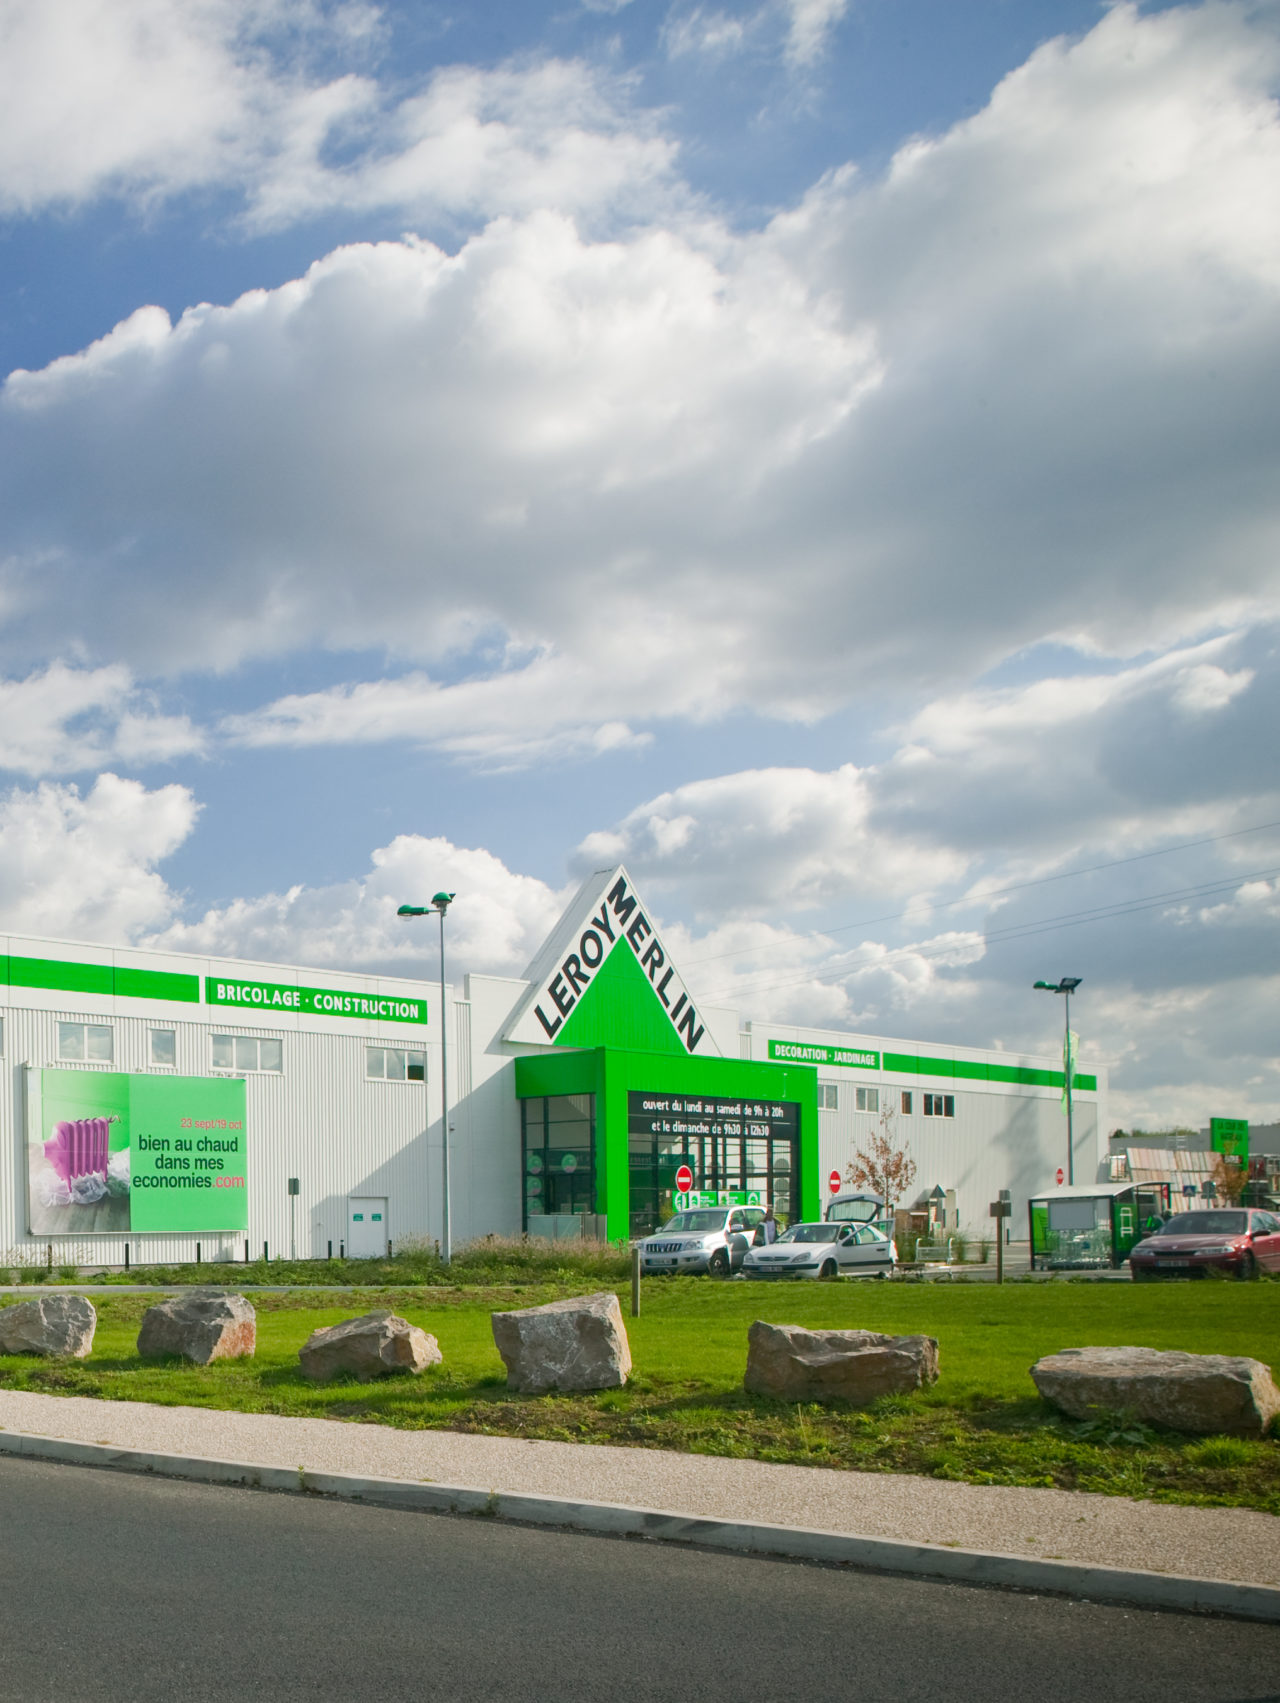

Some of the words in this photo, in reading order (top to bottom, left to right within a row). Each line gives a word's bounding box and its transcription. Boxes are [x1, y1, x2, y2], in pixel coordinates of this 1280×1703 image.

[533, 902, 616, 1040] LEROY
[606, 875, 706, 1054] MERLIN
[217, 984, 300, 1007] BRICOLAGE
[313, 994, 419, 1019] CONSTRUCTION
[775, 1044, 827, 1061] DECORATION
[833, 1051, 875, 1066] JARDINAGE
[642, 1100, 669, 1111] ouvert
[671, 1100, 682, 1111] du
[684, 1100, 702, 1112] lundi
[704, 1104, 714, 1114] au
[716, 1103, 741, 1115] samedi
[754, 1105, 763, 1117] 9h
[771, 1107, 784, 1118] 20h
[181, 1118, 192, 1128] 23
[228, 1120, 243, 1130] oct
[651, 1120, 661, 1131] et
[663, 1120, 670, 1132] le
[672, 1121, 710, 1134] dimanche
[712, 1123, 722, 1134] de
[724, 1123, 741, 1135] 9h30
[750, 1125, 769, 1137] 12h30
[138, 1134, 170, 1151] bien
[174, 1139, 193, 1151] au
[196, 1136, 238, 1152] chaud
[154, 1153, 190, 1170] dans
[194, 1157, 224, 1170] mes
[132, 1172, 245, 1188] economies.com
